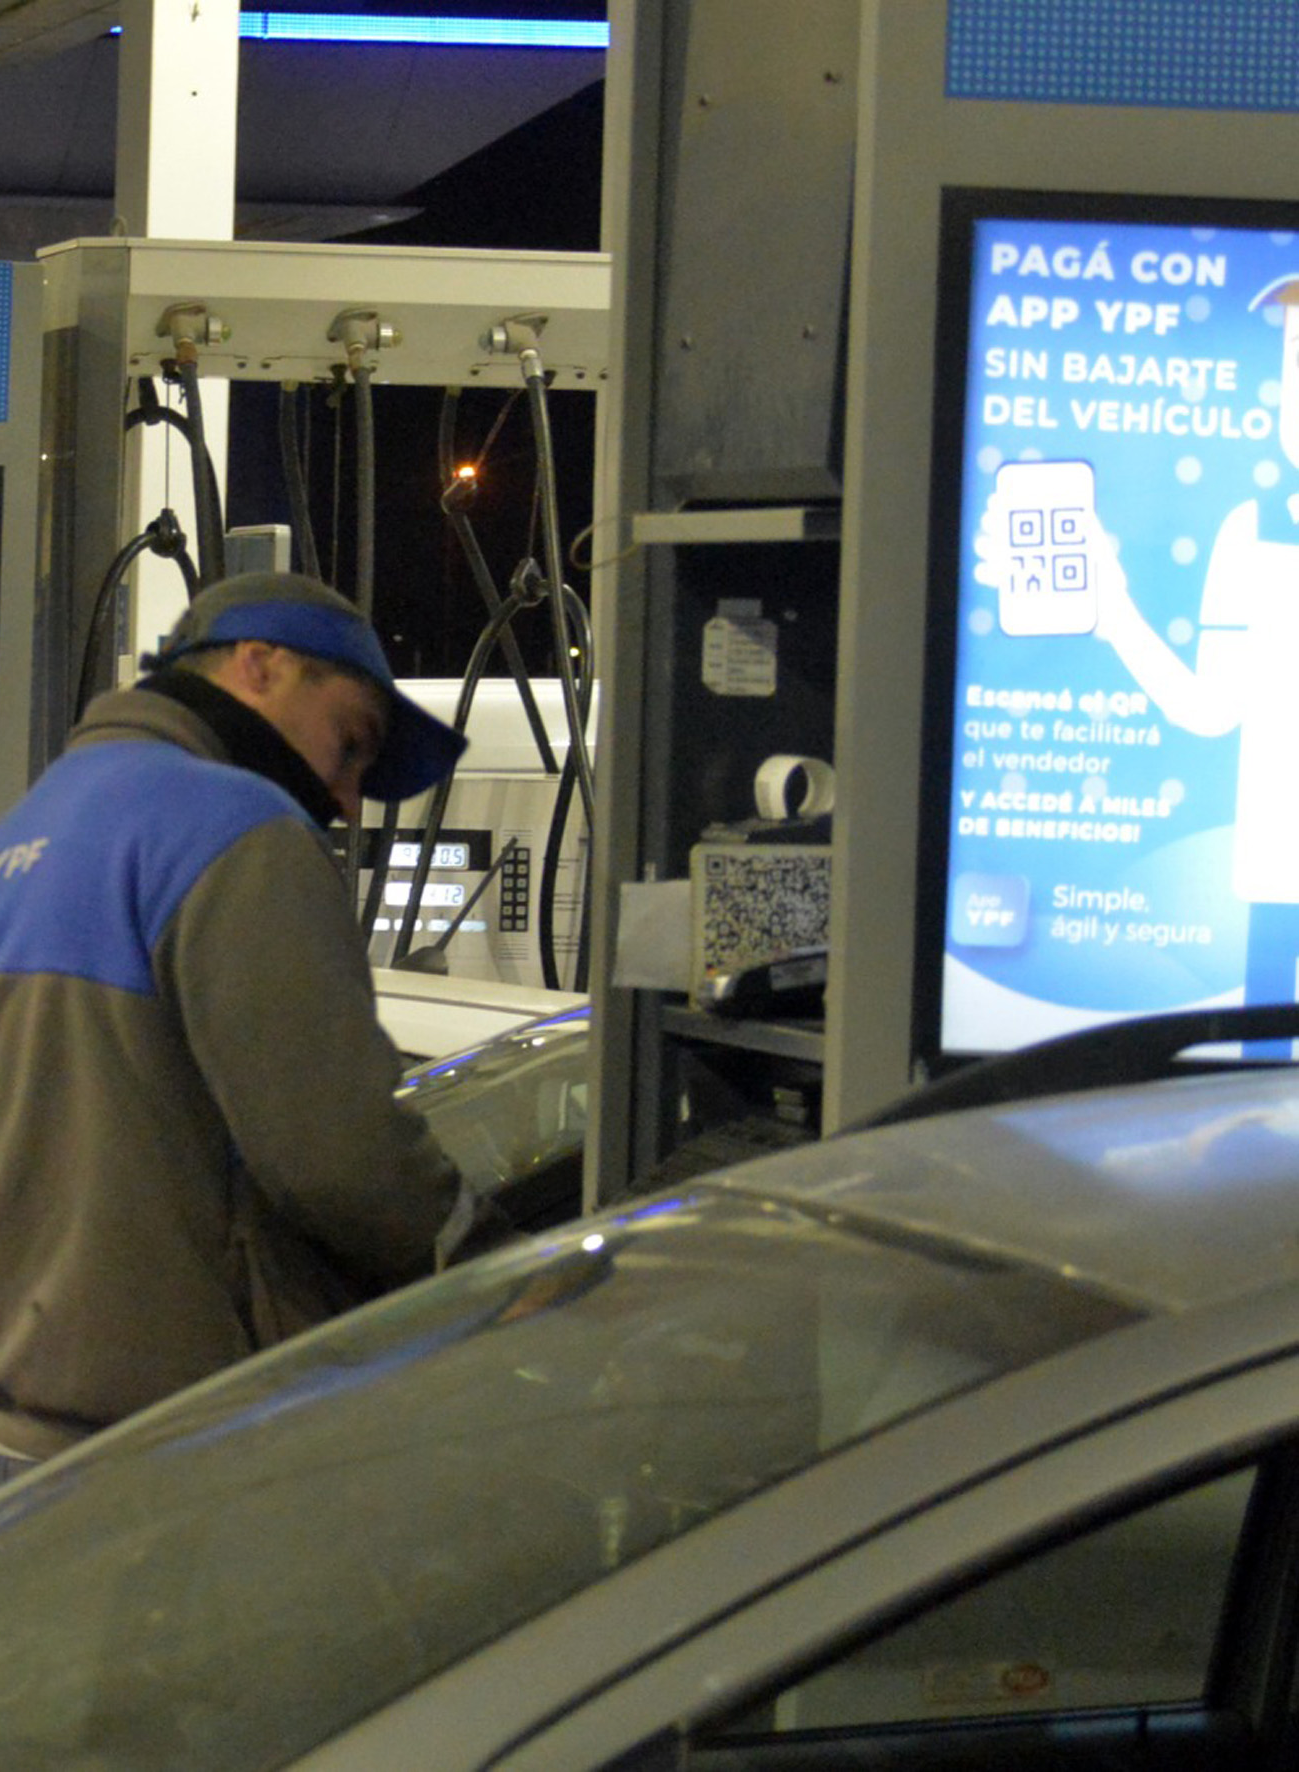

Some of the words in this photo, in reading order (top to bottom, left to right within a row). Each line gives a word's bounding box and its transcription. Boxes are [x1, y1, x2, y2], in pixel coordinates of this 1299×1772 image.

[991, 240, 1114, 281] PAGÁ
[1131, 252, 1227, 287] CON
[986, 294, 1080, 330] APP
[1095, 300, 1181, 336] YPF
[984, 347, 1048, 381] SIN
[1062, 351, 1238, 391] BAJARTE
[982, 394, 1059, 429] DEL
[1070, 396, 1274, 440] VEHÍCULO
[966, 685, 1073, 712] Escaneá
[964, 720, 1013, 742] que
[1020, 719, 1045, 740] te
[1052, 719, 1161, 747] facilitará
[962, 747, 985, 768] el
[992, 750, 1112, 774] vendedor
[961, 790, 975, 808] Y
[980, 790, 1073, 814] ACCEDÉ
[1078, 798, 1096, 815] A
[1102, 796, 1172, 819] MILES
[958, 817, 989, 836] DE
[995, 818, 1142, 844] BENEFICIOS!
[967, 910, 1014, 927] YPF
[1051, 914, 1098, 943] ágil
[1104, 921, 1119, 945] y
[1125, 923, 1213, 947] segura
